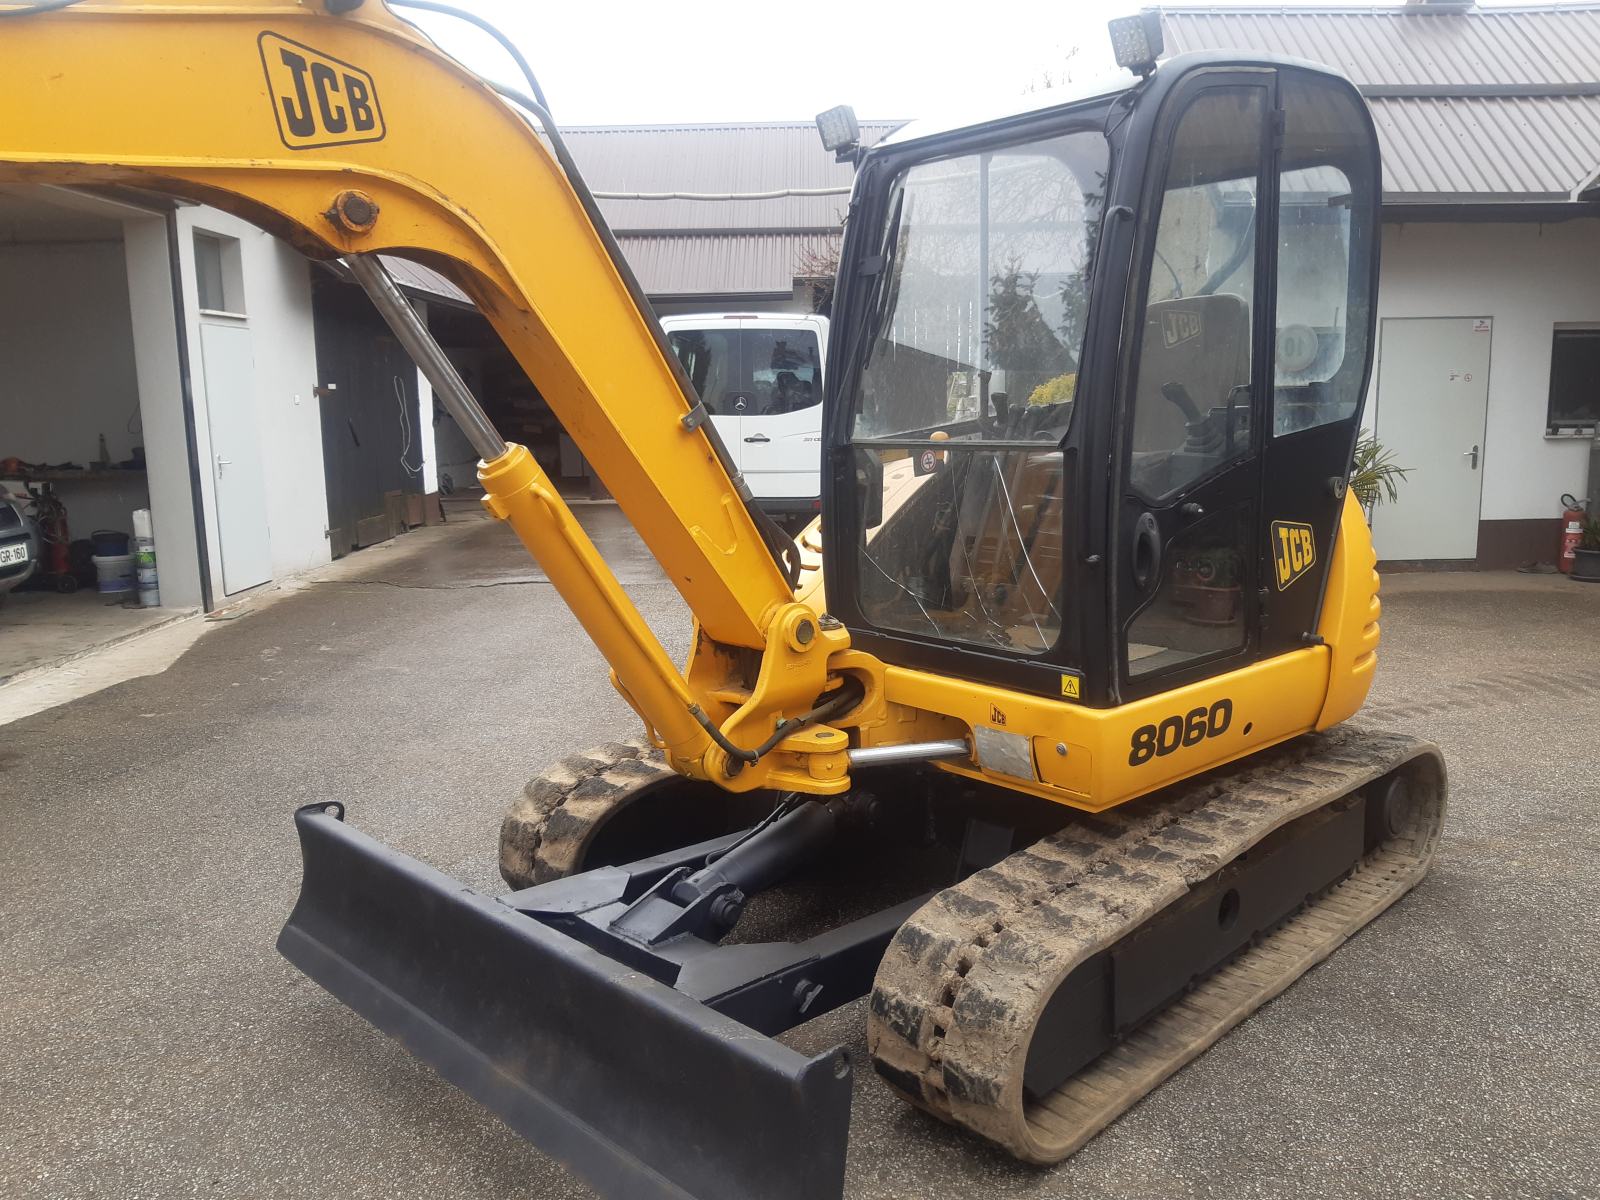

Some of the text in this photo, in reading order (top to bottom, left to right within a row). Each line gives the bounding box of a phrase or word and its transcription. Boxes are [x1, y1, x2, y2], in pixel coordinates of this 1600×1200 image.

[279, 47, 375, 137] JCB
[1167, 313, 1200, 344] JCB
[0, 546, 26, 563] GR-160
[1278, 527, 1313, 584] JCB
[991, 706, 1007, 724] JCB
[1128, 698, 1233, 767] 8060
